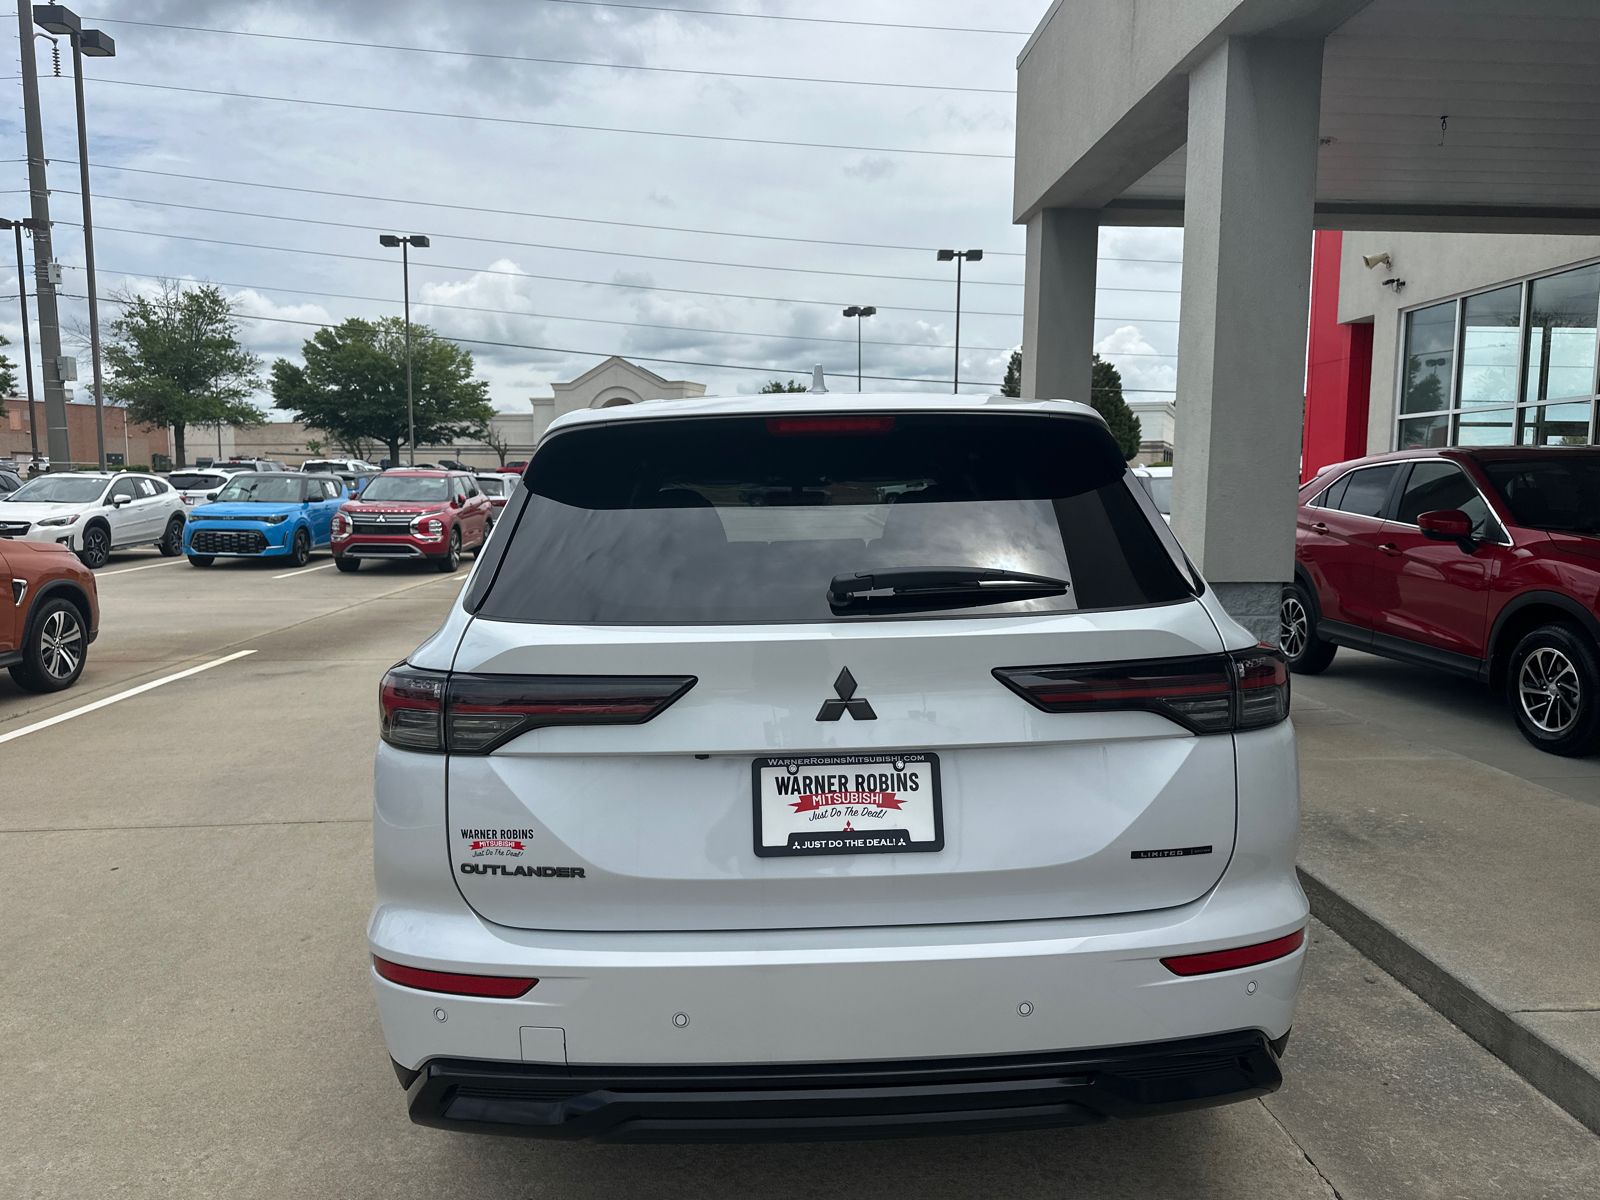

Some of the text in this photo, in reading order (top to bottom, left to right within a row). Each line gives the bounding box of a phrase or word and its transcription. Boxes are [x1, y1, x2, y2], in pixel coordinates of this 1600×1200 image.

[775, 772, 919, 796] WARNER ROBINS
[812, 793, 883, 806] MITSUBISHI
[809, 806, 888, 821] Just Do The Deal!
[461, 829, 534, 840] WARNER ROBINS
[479, 840, 515, 848] MITSUBISHI
[802, 838, 896, 849] JUST DO THE DEAL!
[472, 850, 485, 858] Just
[494, 848, 505, 856] The
[1140, 850, 1184, 858] LIMITED
[460, 863, 586, 878] OUTLANDER
